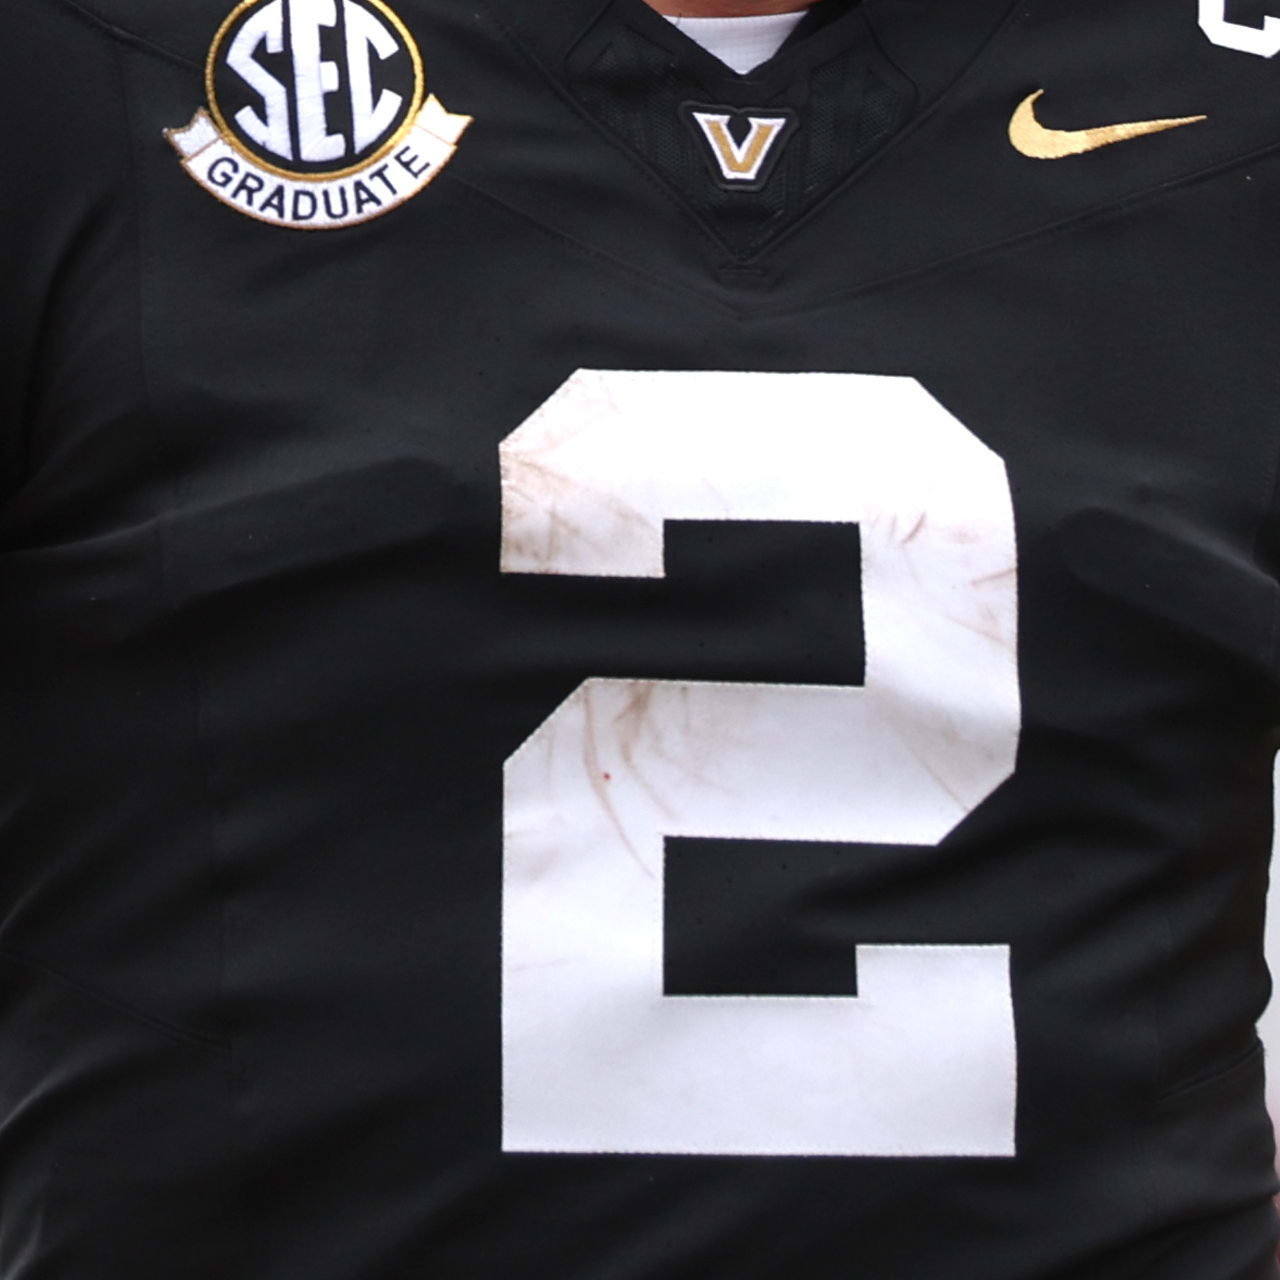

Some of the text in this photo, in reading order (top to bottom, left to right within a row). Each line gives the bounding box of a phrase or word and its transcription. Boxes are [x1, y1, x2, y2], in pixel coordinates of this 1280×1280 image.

[206, 145, 431, 221] GRADUATE
[693, 111, 787, 180] V
[498, 367, 1022, 1158] 2
